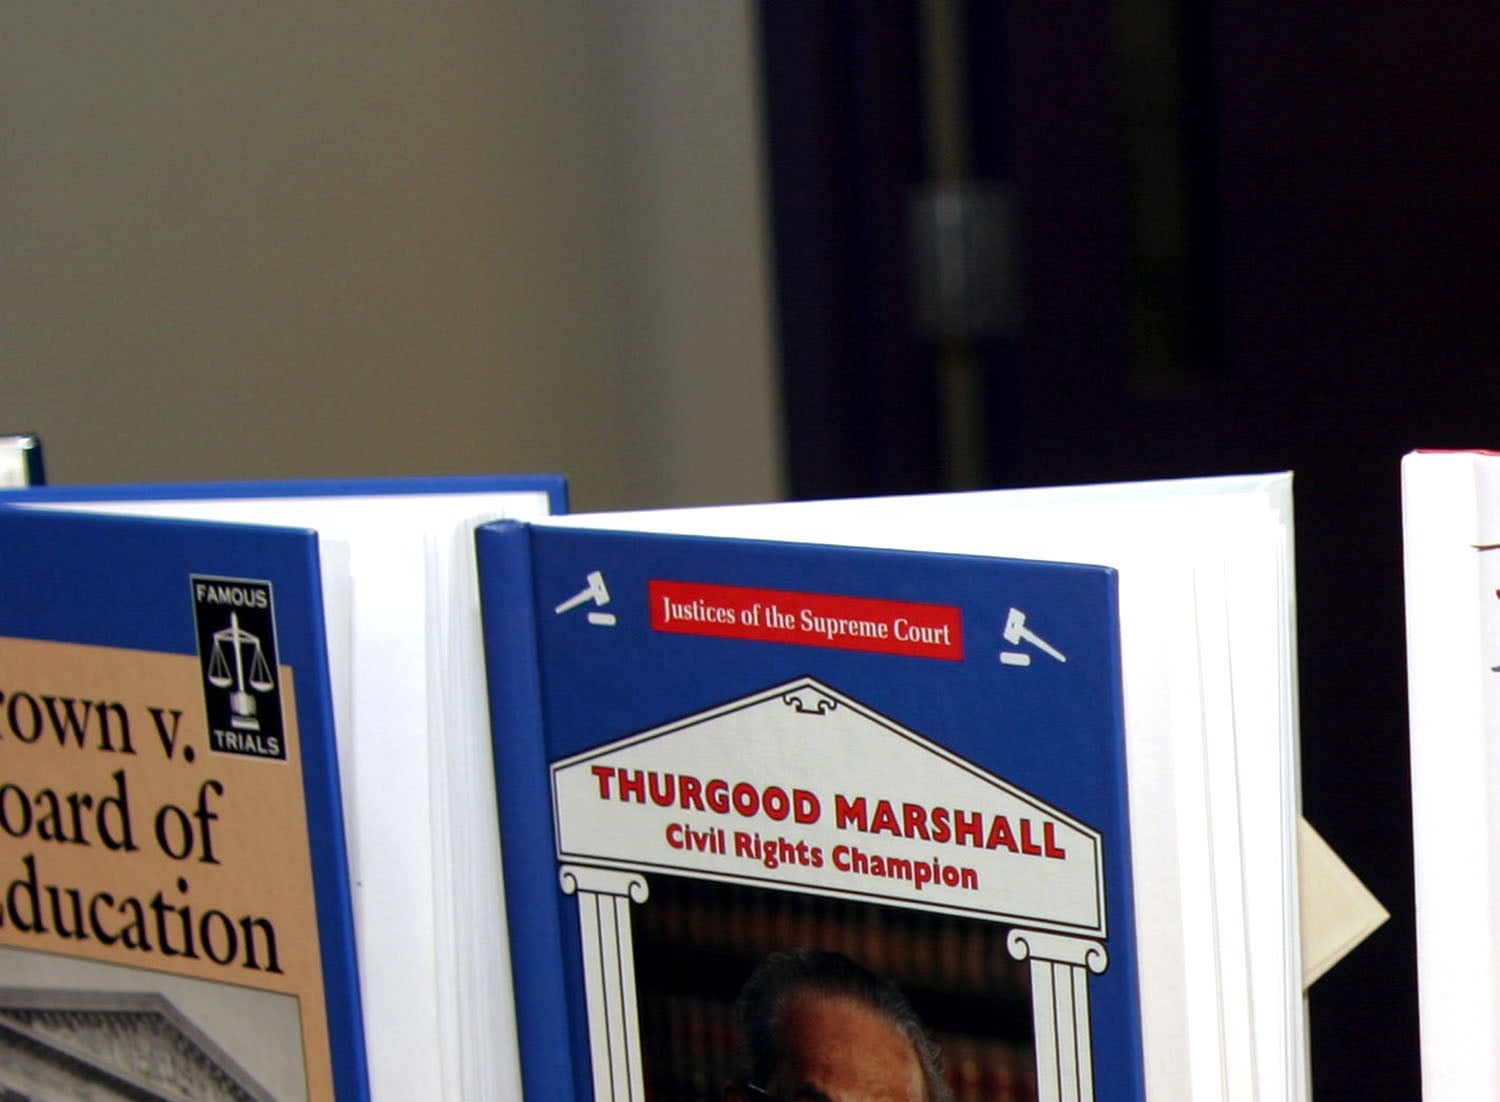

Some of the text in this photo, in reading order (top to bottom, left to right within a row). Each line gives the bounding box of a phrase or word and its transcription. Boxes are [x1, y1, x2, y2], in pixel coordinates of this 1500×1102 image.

[195, 584, 268, 609] FAMOUS
[663, 596, 951, 645] Justices of the Supreme Court
[148, 705, 195, 763] v.
[214, 730, 280, 755] TRIALS
[154, 779, 225, 865] of
[591, 765, 1065, 859] THURGOOD MARSHALL
[665, 823, 979, 891] Civil Rights Champion
